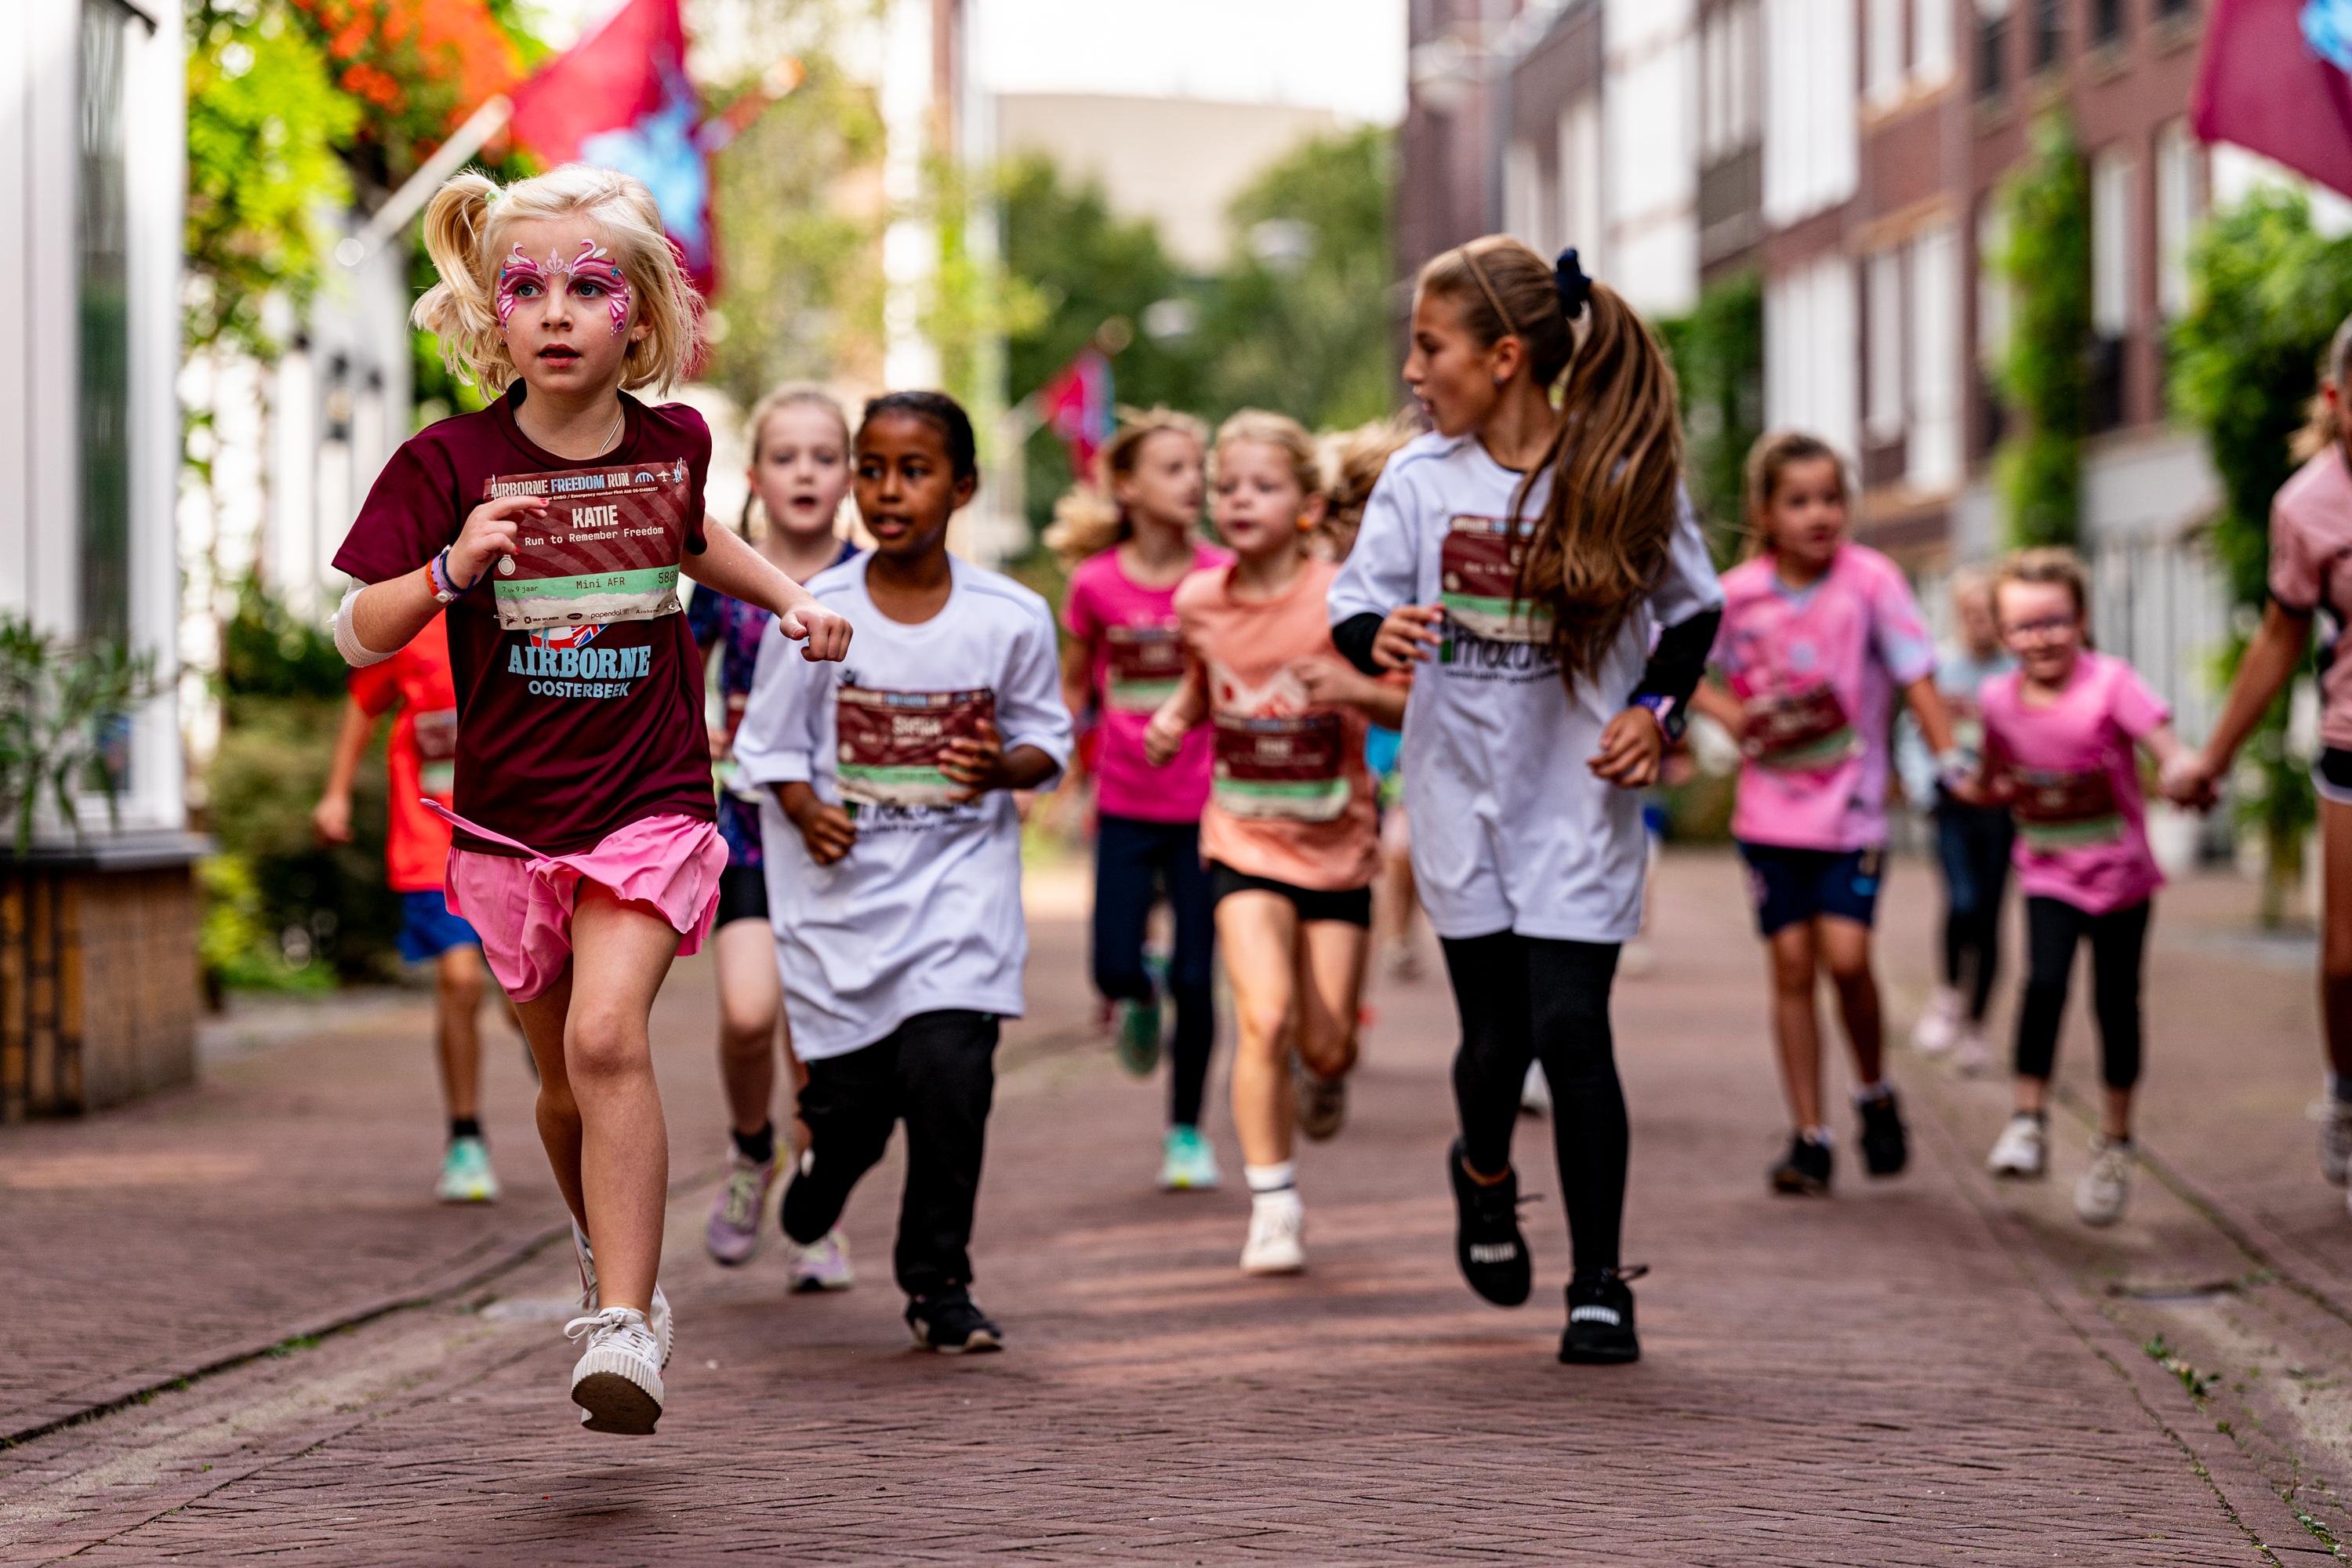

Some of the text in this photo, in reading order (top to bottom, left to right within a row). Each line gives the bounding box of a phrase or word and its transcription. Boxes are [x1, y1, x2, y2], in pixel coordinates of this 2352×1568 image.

[492, 473, 630, 498] AIRBORNE FREEDOM RUN
[572, 504, 619, 529] KATIE
[524, 525, 664, 546] Run to Remember Freedom
[576, 577, 625, 590] Mini AFR
[507, 644, 652, 680] AIRBORNE
[528, 680, 631, 699] OOSTERBEEK
